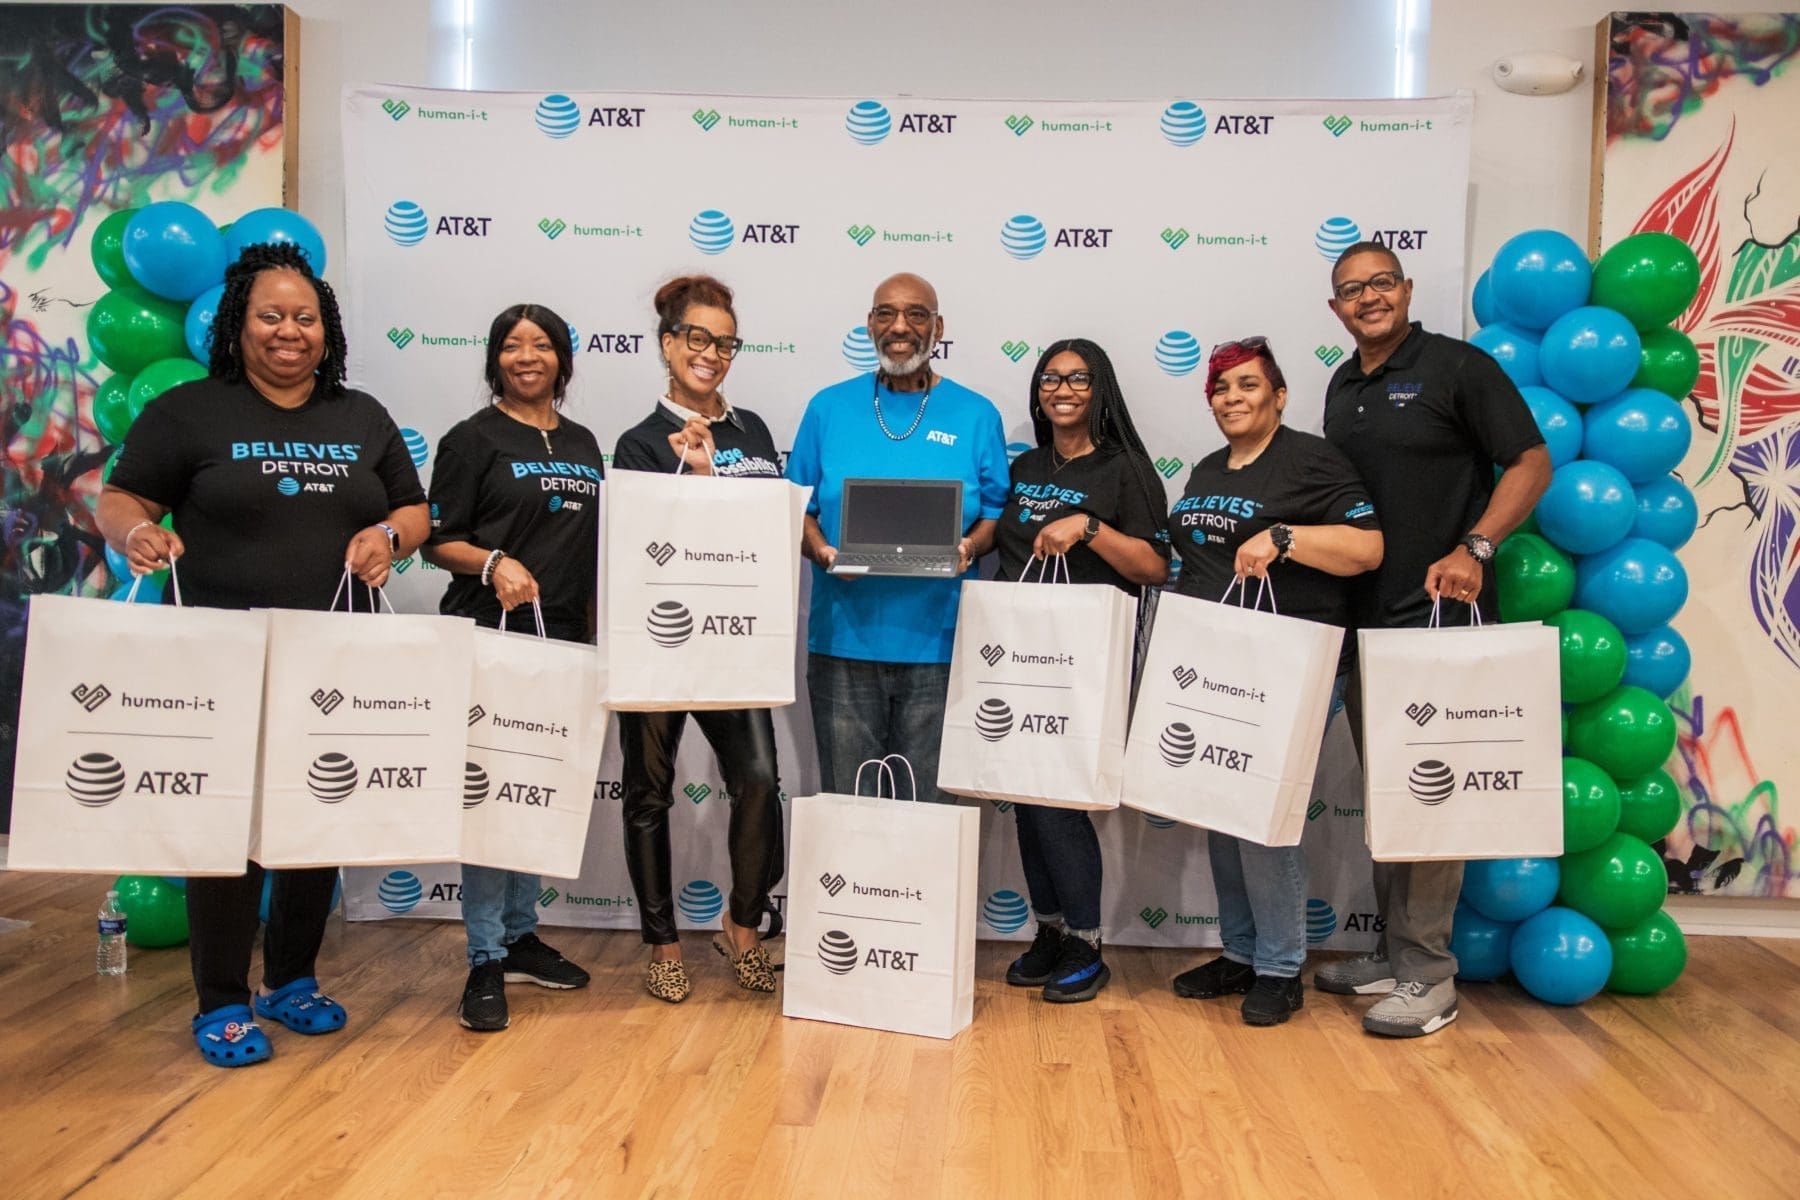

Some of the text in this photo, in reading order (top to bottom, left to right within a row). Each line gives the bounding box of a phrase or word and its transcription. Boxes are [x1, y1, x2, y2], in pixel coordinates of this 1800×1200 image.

[418, 106, 488, 121] human-i-t
[588, 107, 646, 128] AT&T
[728, 114, 798, 129] human-i-t
[899, 113, 957, 134] AT&T
[1041, 119, 1112, 132] human-i-t
[1214, 115, 1275, 135] AT&T
[1360, 118, 1433, 132] human-i-t
[435, 215, 492, 237] AT&T
[573, 223, 642, 237] human-i-t
[742, 224, 800, 244] AT&T
[883, 229, 953, 243] human-i-t
[1054, 228, 1113, 248] AT&T
[1196, 232, 1268, 246] human-i-t
[1371, 230, 1428, 251] AT&T
[421, 334, 489, 347] human-i-t
[587, 333, 644, 354] AT&T
[739, 342, 795, 354] man-i-t
[926, 430, 957, 446] AT&T
[261, 460, 350, 479] DETROIT
[303, 482, 335, 493] AT&T
[540, 476, 599, 497] DETROIT
[562, 500, 583, 511] AT&T
[1181, 512, 1239, 533] DETROIT
[1207, 534, 1226, 544] AT&T
[684, 548, 757, 563] human-i-t
[701, 615, 757, 636] AT&T
[1011, 650, 1074, 666] human-i-t
[1202, 677, 1265, 703] human-i-t
[121, 692, 215, 712] human-i-t
[352, 695, 431, 711] human-i-t
[1445, 705, 1523, 720] human-i-t
[492, 713, 568, 738] human-i-t
[1019, 713, 1070, 735] AT&T
[1199, 743, 1253, 773] AT&T
[134, 770, 209, 795] AT&T
[366, 766, 428, 789] AT&T
[1462, 770, 1523, 791] AT&T
[495, 782, 557, 808] AT&T
[565, 891, 633, 907] human-i-t
[852, 882, 923, 901] human-i-t
[1343, 912, 1387, 933] AT&
[864, 948, 919, 972] AT&T
